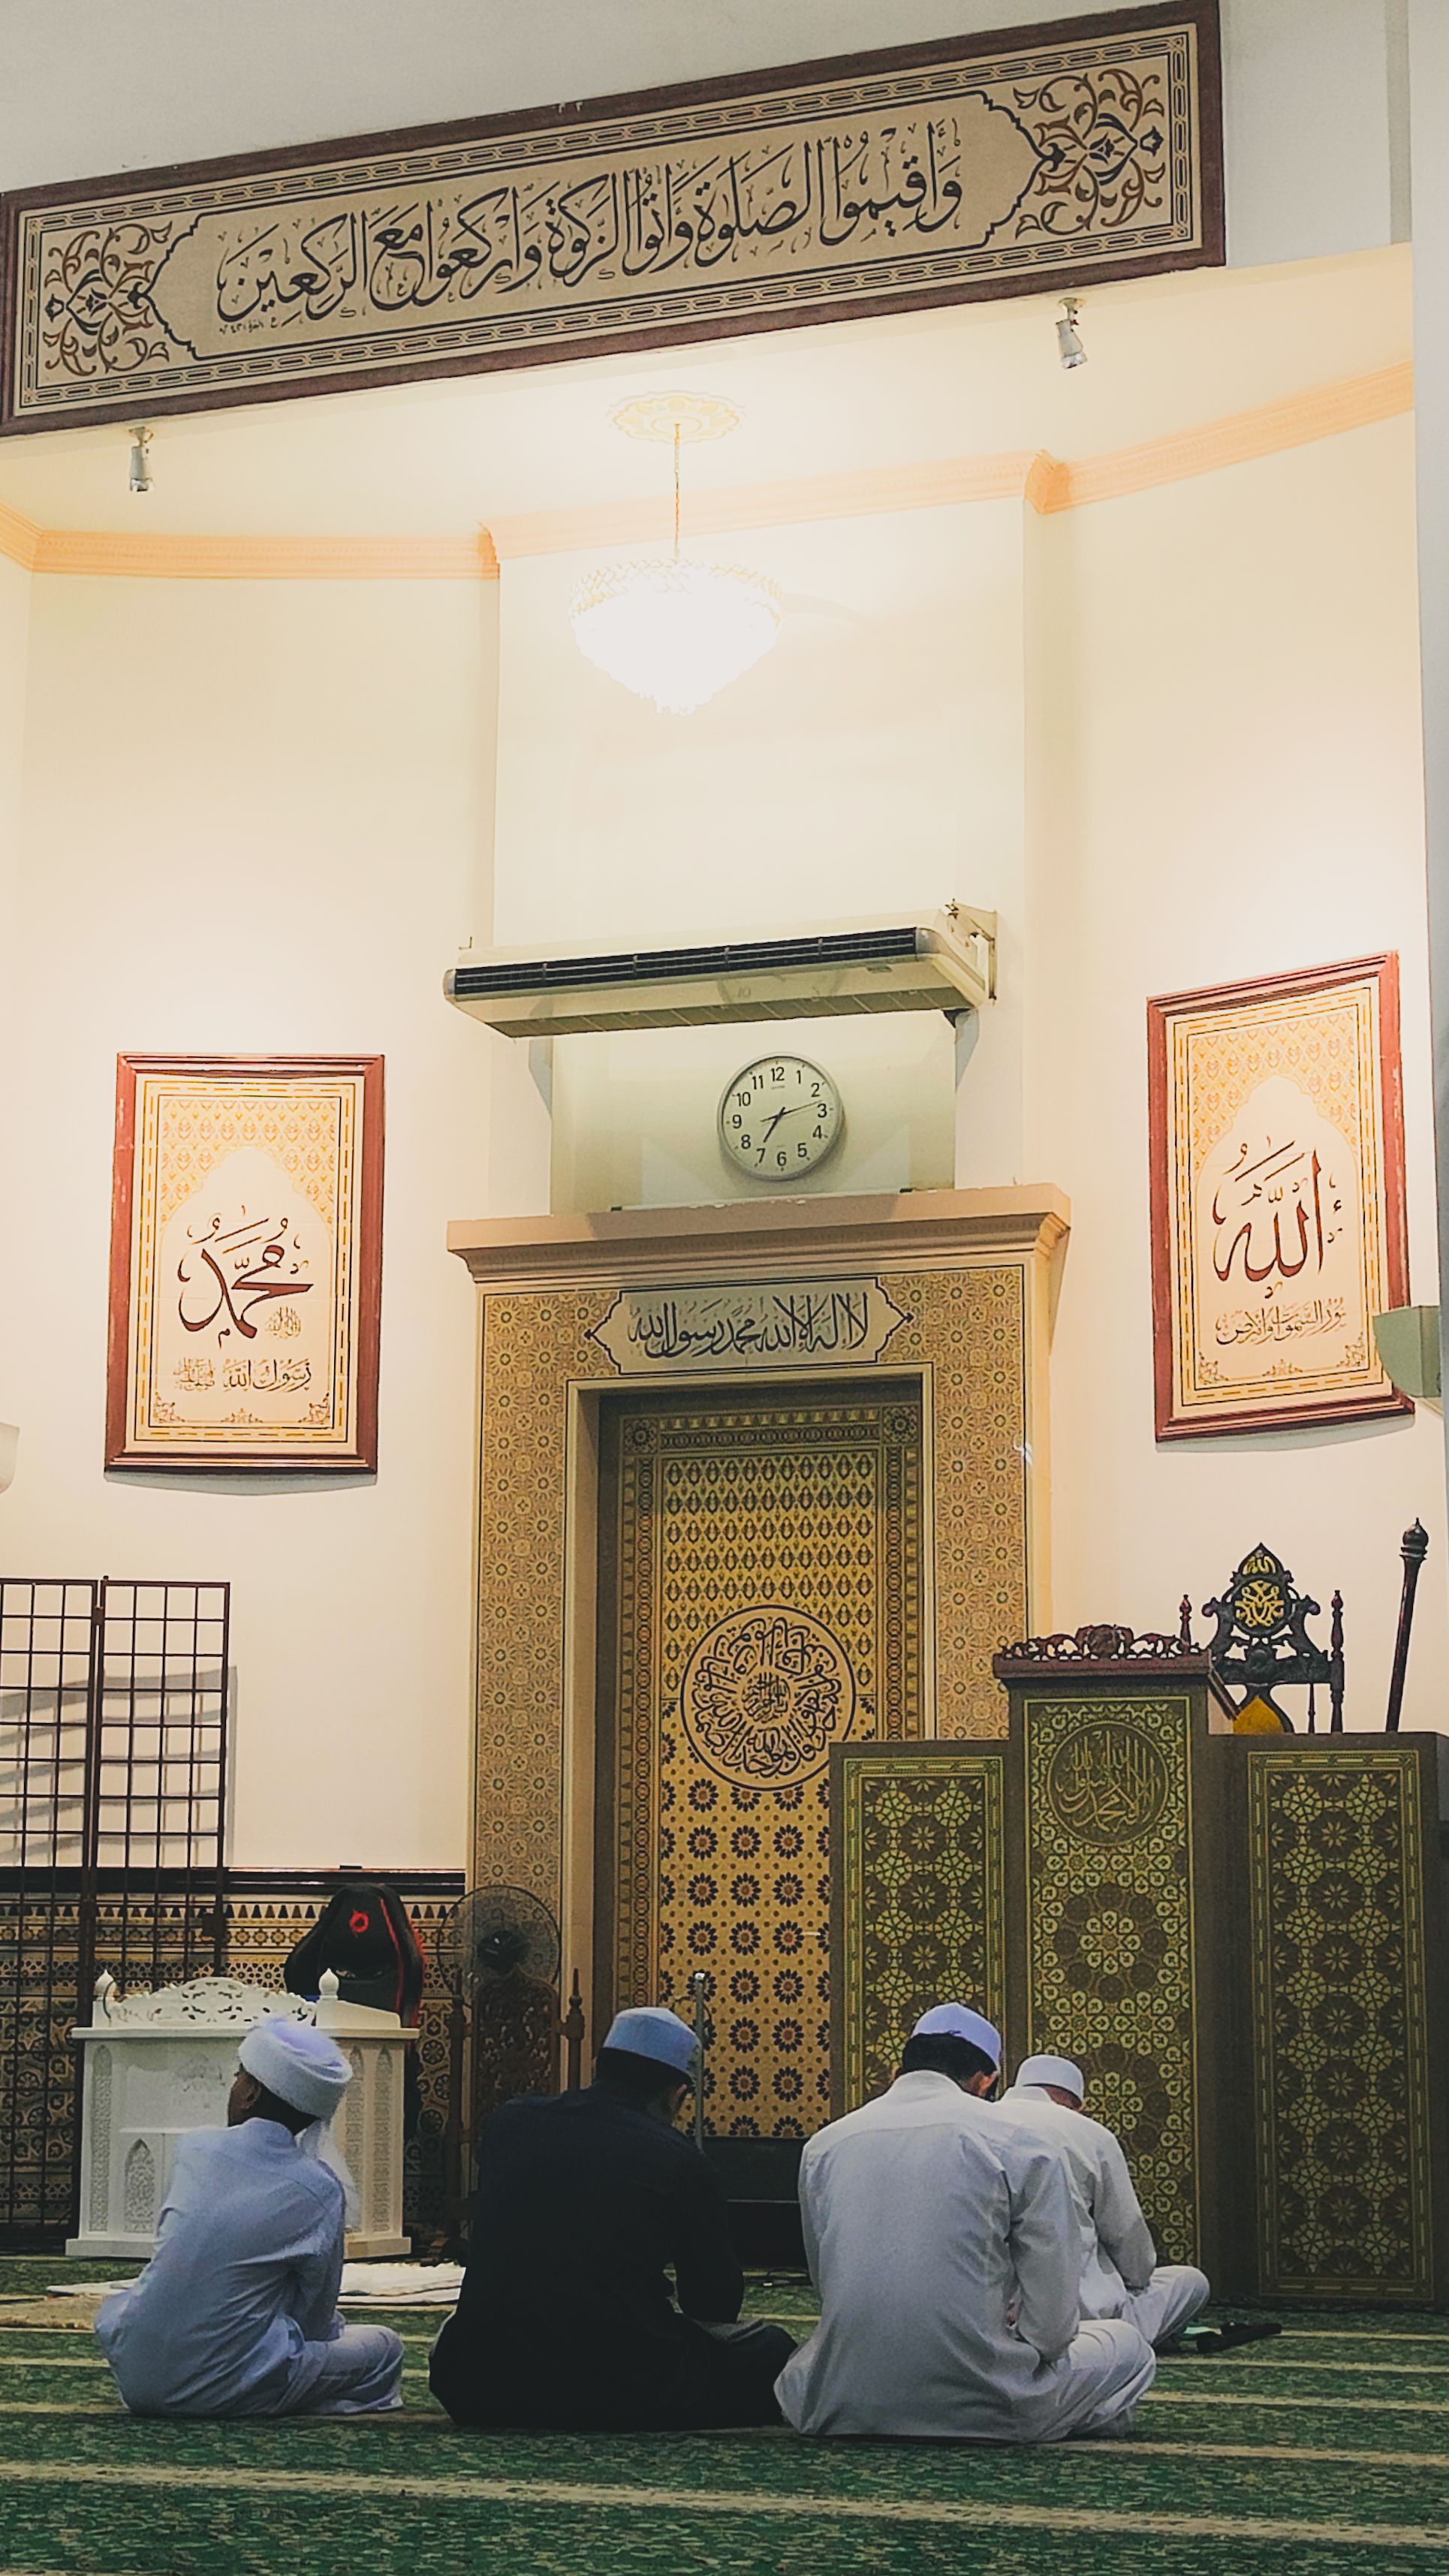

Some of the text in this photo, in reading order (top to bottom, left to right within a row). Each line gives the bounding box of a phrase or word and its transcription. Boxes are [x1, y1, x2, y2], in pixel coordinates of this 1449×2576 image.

[770, 1066, 785, 1082] 12
[797, 1070, 801, 1084] 1
[752, 1075, 764, 1089] 11
[811, 1083, 820, 1097] 2
[737, 1092, 751, 1107] 10
[817, 1103, 827, 1118] 3
[732, 1115, 742, 1128] 9
[812, 1125, 822, 1139] 4
[741, 1134, 751, 1149] 8
[756, 1148, 765, 1163] 7
[797, 1143, 807, 1157] 5
[777, 1152, 787, 1166] 6
